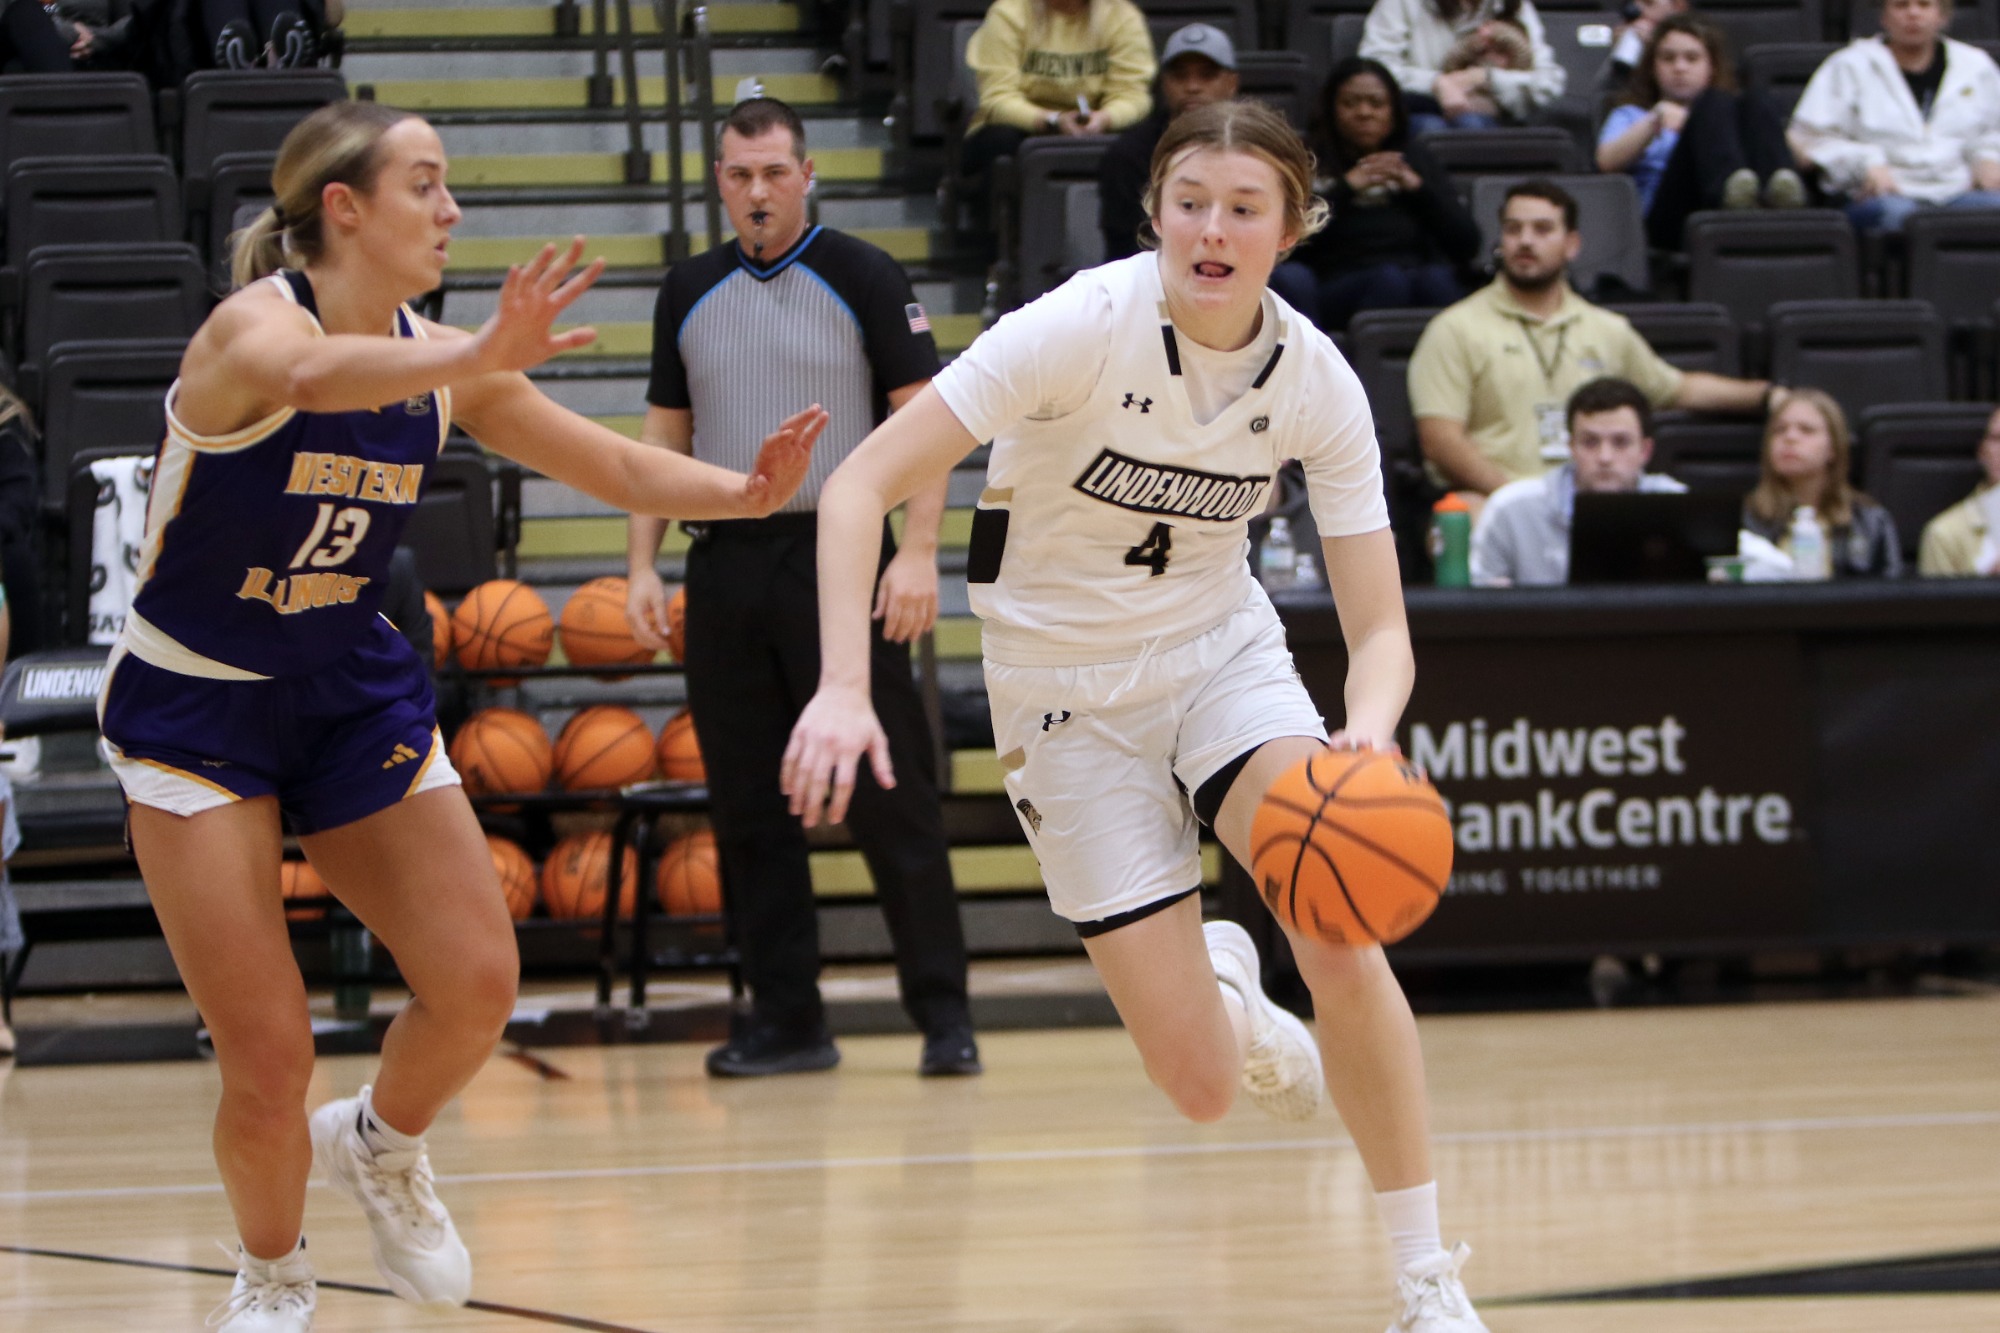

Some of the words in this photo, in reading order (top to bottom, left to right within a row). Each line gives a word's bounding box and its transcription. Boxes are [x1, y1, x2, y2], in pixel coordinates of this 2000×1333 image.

[284, 452, 424, 504] WESTERN
[1081, 456, 1268, 519] LINDENWOOD
[288, 503, 371, 569] 13
[1124, 522, 1175, 577] 4
[235, 567, 371, 615] ILLINOIS
[1410, 715, 1686, 780] Midwest
[1446, 786, 1792, 852] ankCentre
[1519, 864, 1661, 893] TOGETHER
